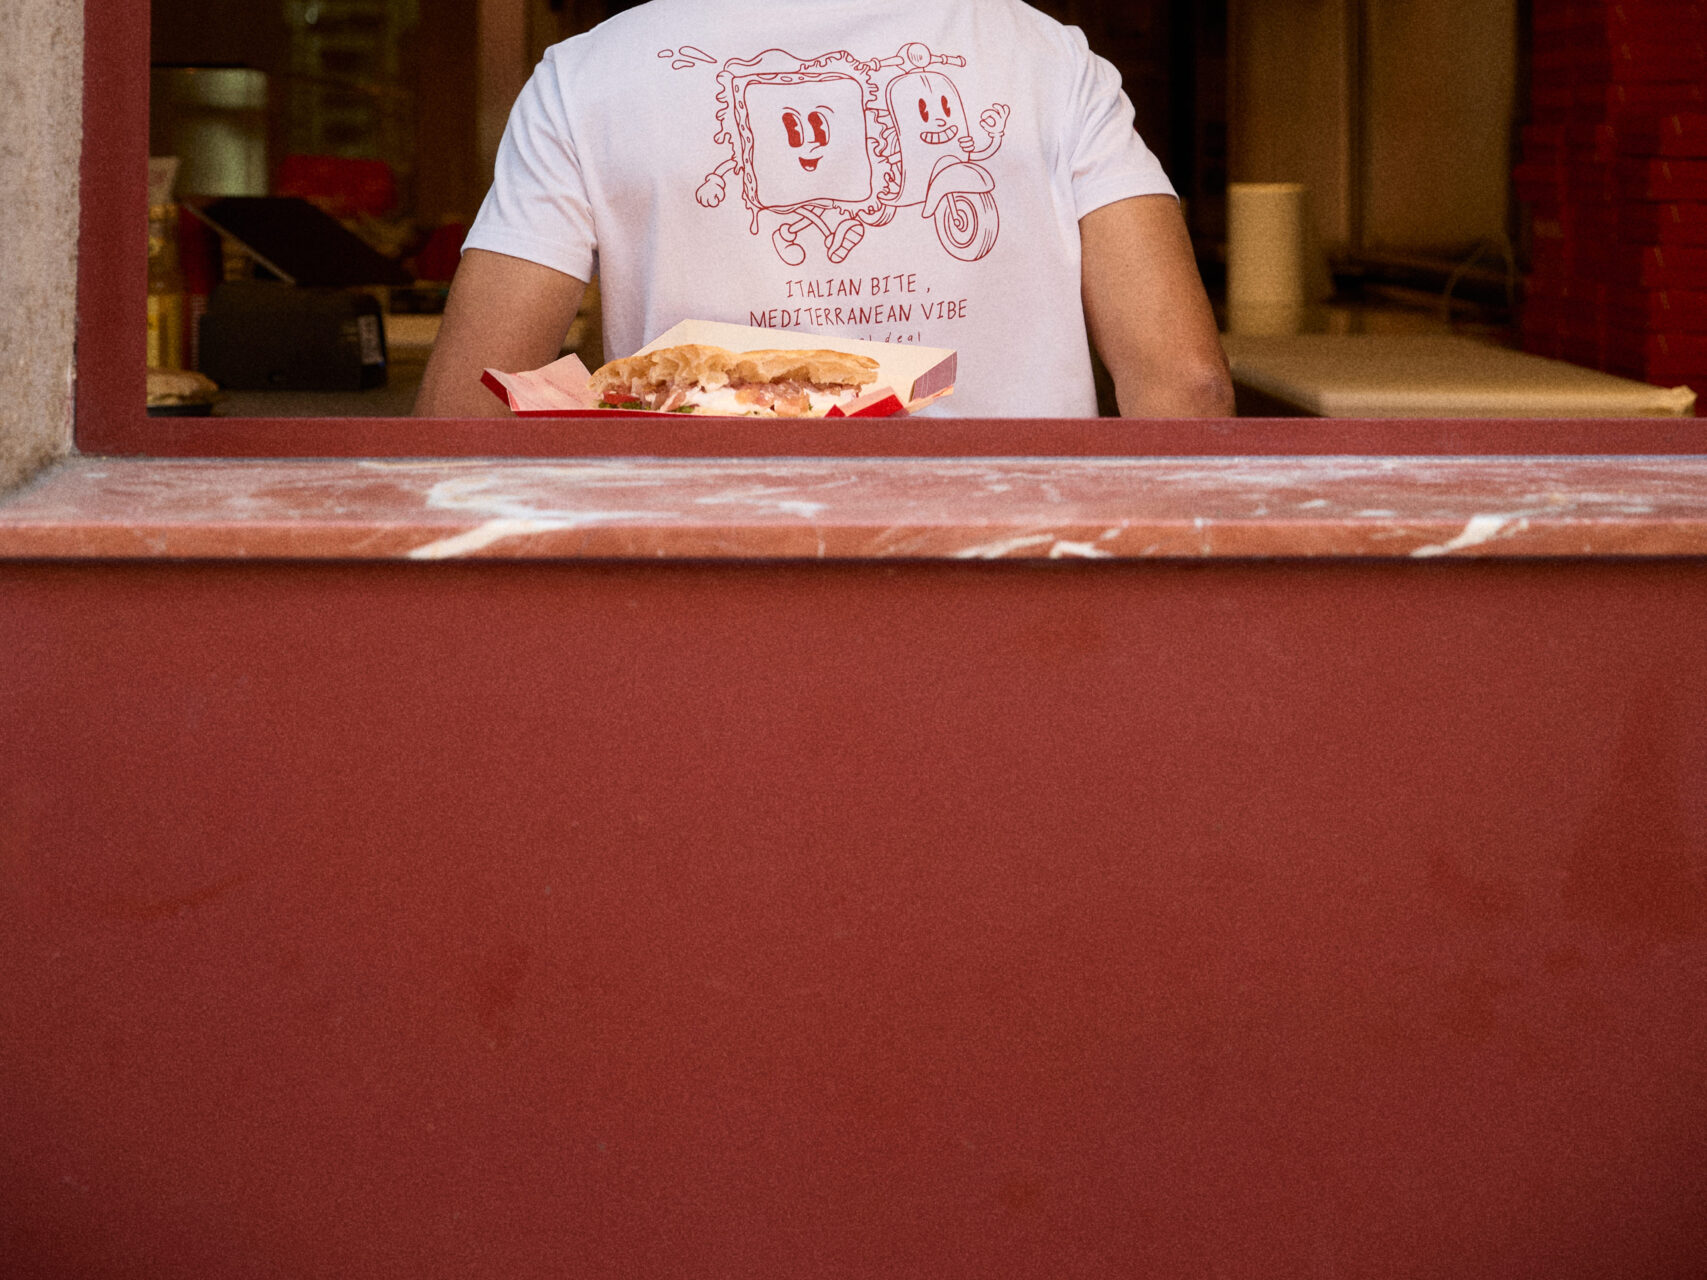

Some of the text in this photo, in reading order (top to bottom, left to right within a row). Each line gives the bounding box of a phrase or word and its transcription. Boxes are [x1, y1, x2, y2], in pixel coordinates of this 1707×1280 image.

[785, 277, 862, 299] ITALIAN
[749, 298, 968, 328] MEDITERRANEAN VIBE
